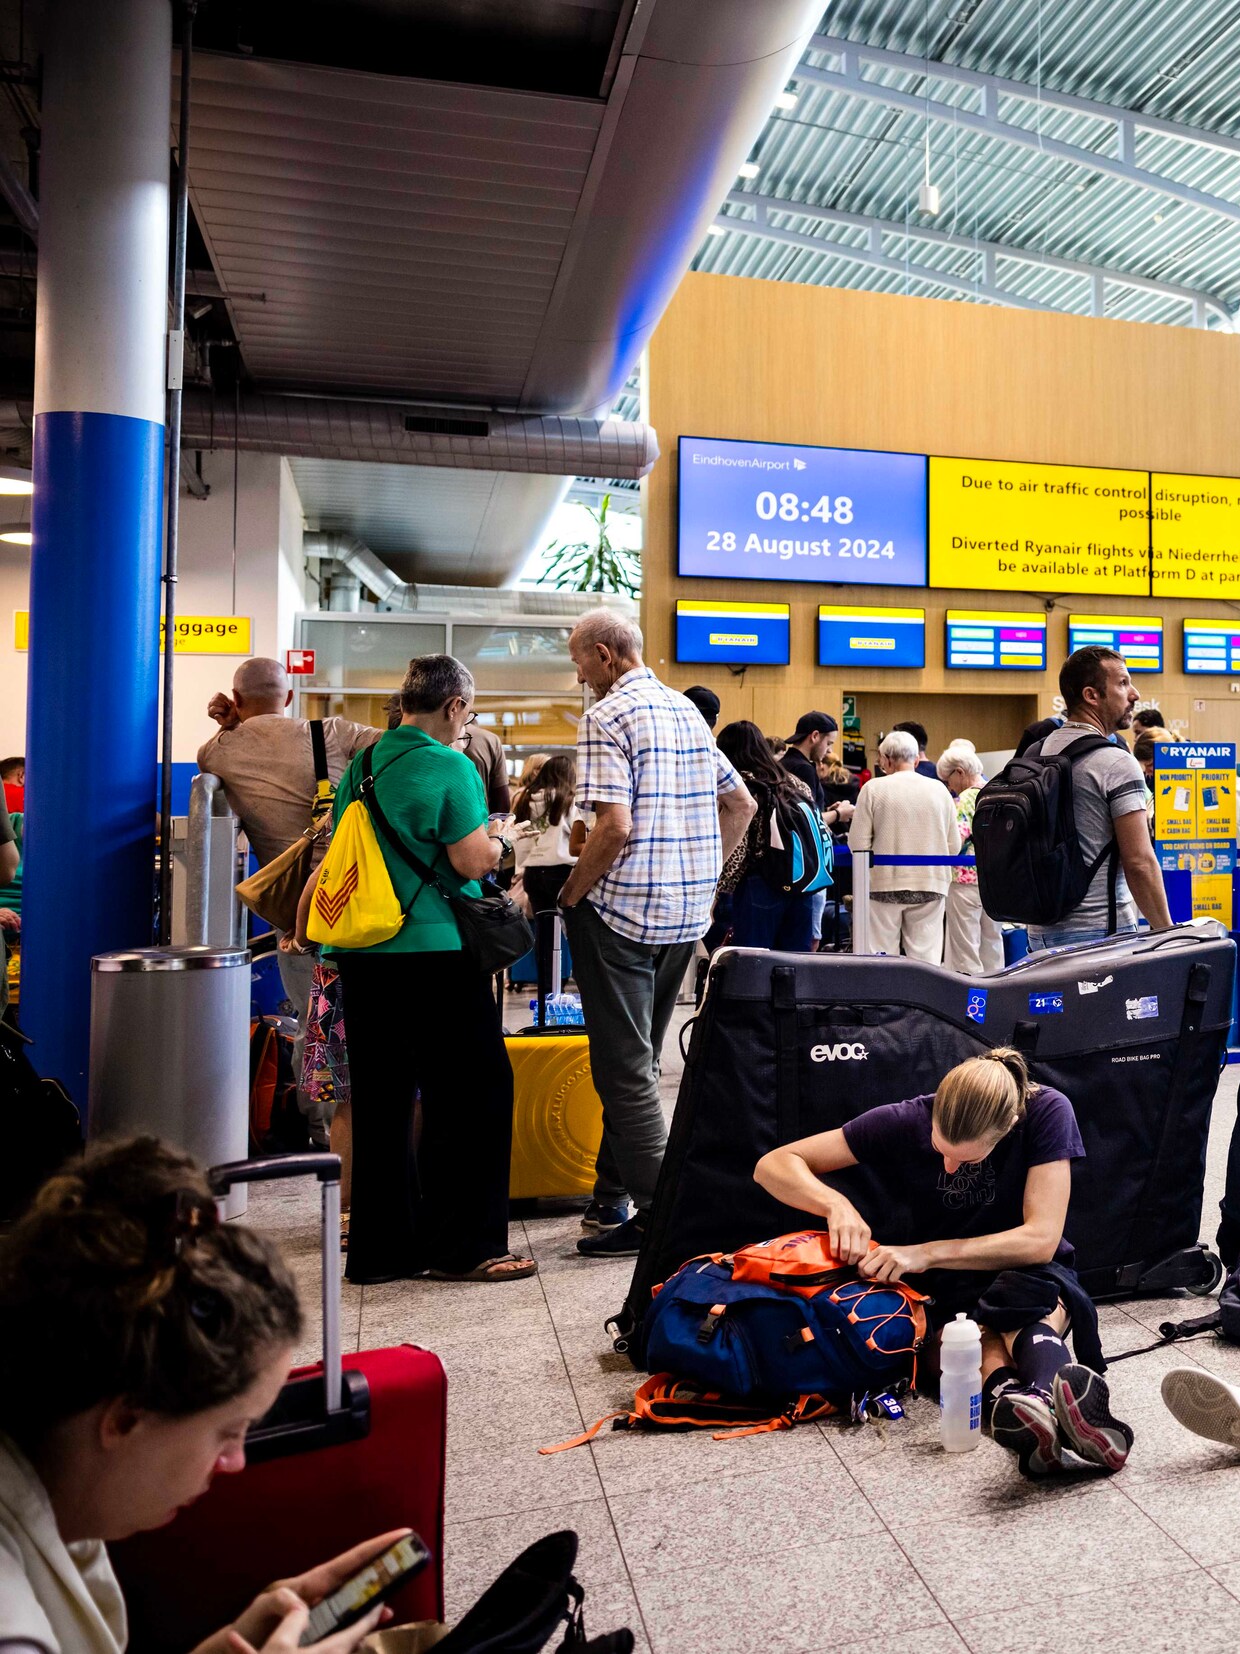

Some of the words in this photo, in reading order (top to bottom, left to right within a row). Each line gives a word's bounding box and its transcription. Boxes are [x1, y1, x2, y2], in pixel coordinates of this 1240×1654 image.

[692, 454, 790, 471] EindhovenAirport
[962, 476, 993, 489] Due
[998, 479, 1014, 491] to
[1019, 479, 1039, 493] air
[1044, 482, 1089, 496] traffic
[1094, 487, 1147, 500] control
[1155, 489, 1232, 507] disruption,
[755, 491, 854, 525] 08:48
[1119, 508, 1182, 522] possible
[706, 531, 737, 552] 28
[744, 533, 831, 560] August
[838, 538, 896, 560] 2024
[952, 536, 1019, 552] Diverted
[1025, 540, 1082, 557] Ryanair
[1087, 542, 1134, 560] flights
[1139, 547, 1163, 560] via
[998, 559, 1017, 573] be
[1022, 561, 1089, 576] available
[1094, 565, 1108, 577] at
[1113, 565, 1180, 580] Platform
[1186, 569, 1196, 580] D
[1201, 571, 1214, 582] at
[1170, 747, 1231, 757] RYANAIR
[1035, 999, 1046, 1008] 21
[884, 1398, 902, 1414] 36
